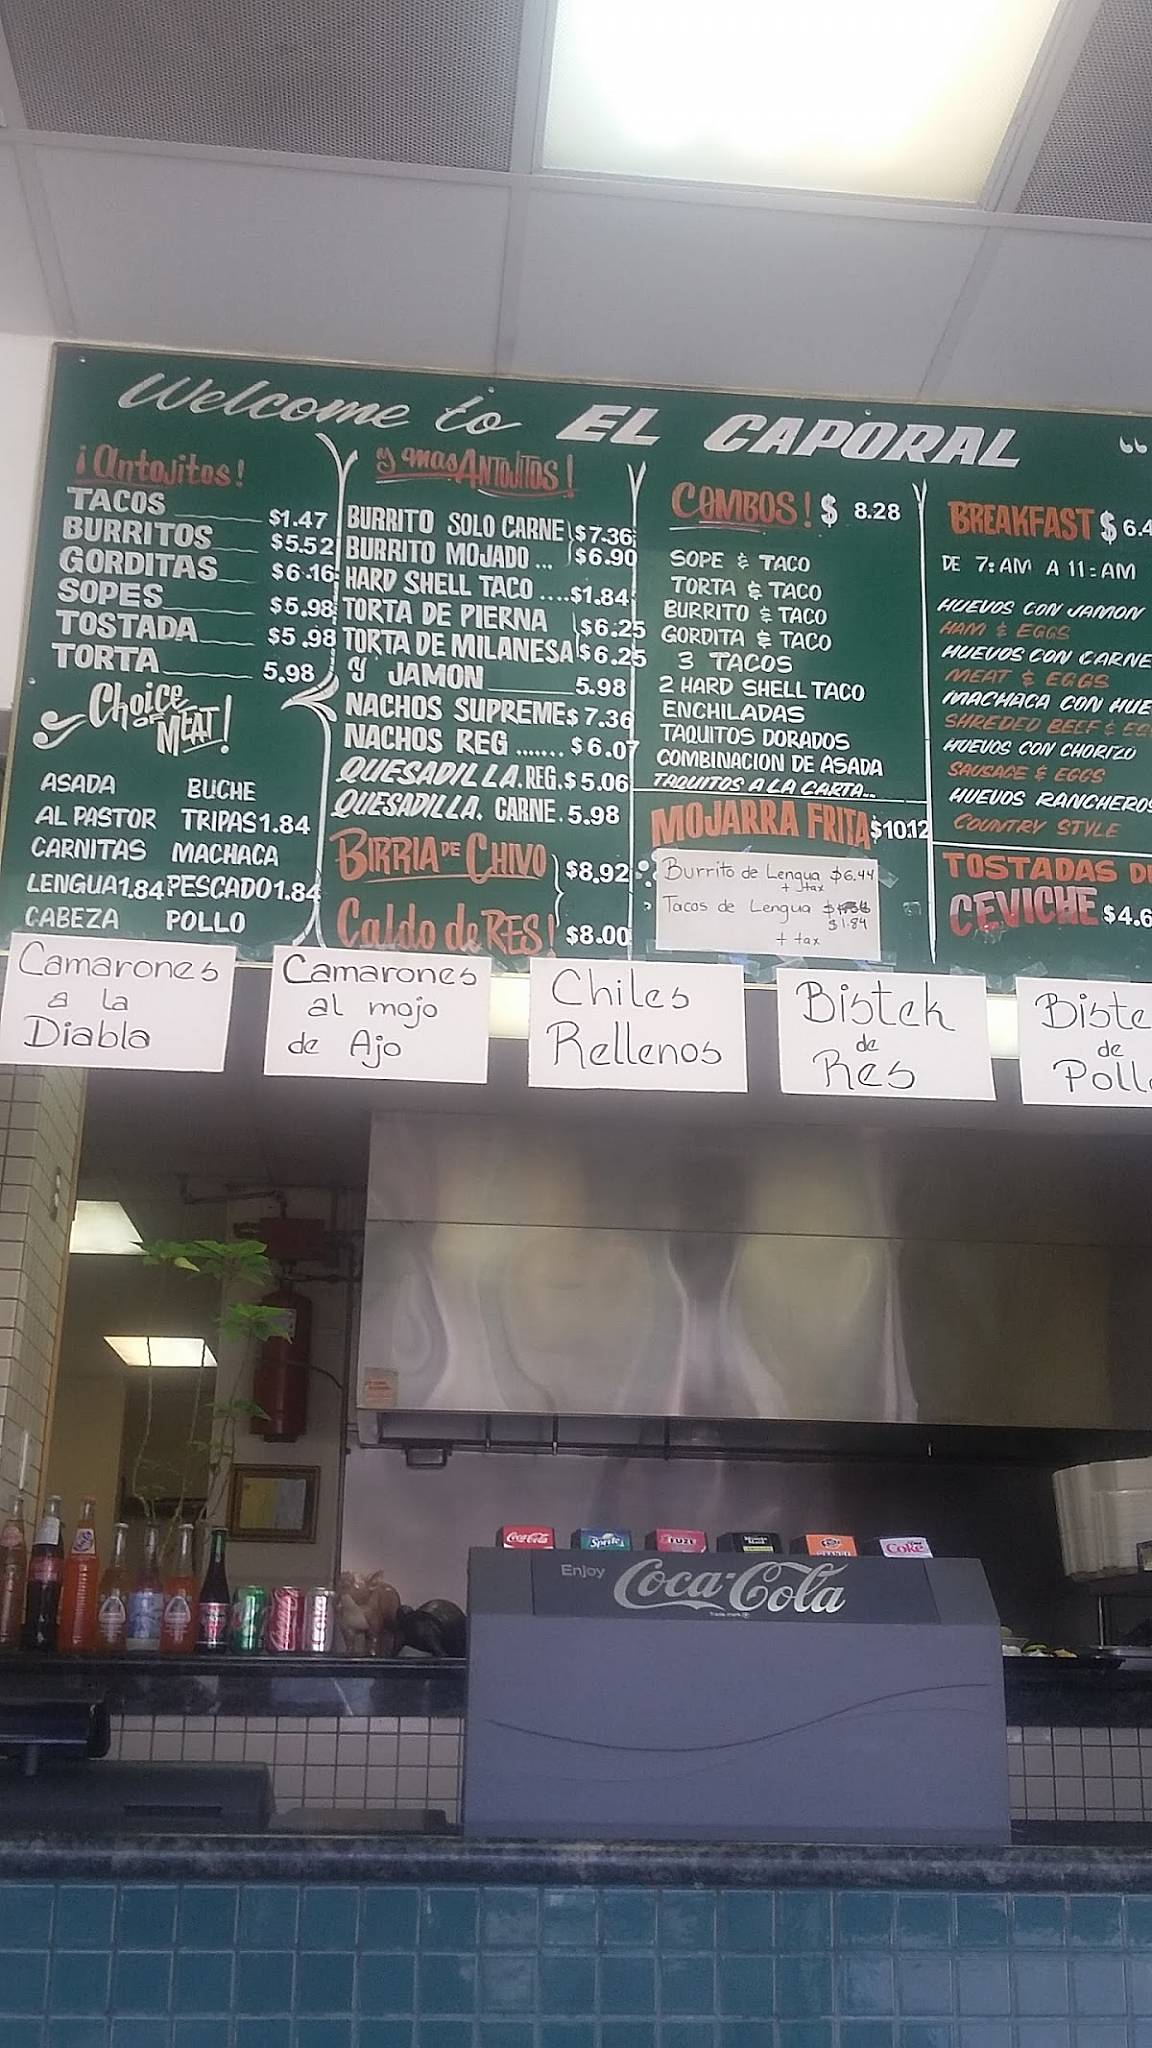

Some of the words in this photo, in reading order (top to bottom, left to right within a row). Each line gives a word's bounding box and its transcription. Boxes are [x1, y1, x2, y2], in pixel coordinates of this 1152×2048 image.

[117, 372, 410, 429] Welcome
[435, 395, 523, 435] to
[555, 404, 661, 446] EL
[703, 414, 1020, 469] CAPORAL
[67, 486, 166, 515] TACOS
[268, 508, 329, 531] $1.47
[820, 493, 838, 528] $
[854, 502, 901, 521] 8.28
[347, 504, 434, 534] BURRITO
[448, 512, 495, 539] SOLO
[501, 515, 564, 543] CARNE
[574, 524, 634, 546] $7.36
[948, 500, 1095, 541] BREAKFAST
[1100, 510, 1118, 545] $
[62, 516, 213, 551] BURRITOS
[270, 533, 335, 556] $5.52
[59, 545, 218, 581] GORDITAS
[346, 534, 436, 565] BURRITO
[446, 542, 529, 569] MOJADO
[574, 548, 638, 567] $6.90
[670, 550, 724, 569] SOPE
[759, 554, 811, 573] TACO
[942, 554, 961, 572] DE
[1046, 560, 1059, 576] A
[57, 577, 164, 609] SOPES
[346, 566, 398, 593] HARD
[403, 569, 472, 597] SHELL
[478, 574, 534, 600] TACO
[570, 585, 630, 607] $1.84
[670, 576, 736, 596] TORTA
[768, 581, 822, 601] TACO
[343, 597, 413, 624] TORTA
[422, 600, 452, 627] DE
[460, 603, 548, 632] PIERNA
[580, 618, 646, 639] $6.25
[663, 600, 749, 622] BURRITO
[777, 606, 828, 625] TACO
[936, 598, 1015, 615] HUEVOS
[1023, 602, 1064, 618] CON
[1067, 604, 1146, 621] JAMON
[56, 609, 198, 643] TOSTADA
[661, 625, 745, 646] GORDITA
[780, 631, 832, 651] TACO
[939, 621, 987, 637] HAM
[1016, 623, 1071, 641] EGGS
[342, 627, 411, 654] TORTA
[416, 630, 446, 657] DE
[451, 633, 574, 664] MILANESA
[578, 644, 647, 668] $6.25
[941, 644, 1025, 662] HUEVOS
[1028, 648, 1073, 665] CON
[1078, 650, 1152, 669] CARNE
[51, 642, 160, 674] TORTA
[263, 661, 315, 683] 5.98
[709, 651, 793, 673] TACOS
[388, 662, 484, 690] JAMON
[575, 677, 627, 697] 5.98
[659, 675, 674, 693] 2
[681, 676, 734, 696] HARD
[742, 679, 808, 699] SHELL
[811, 681, 866, 701] TACO
[944, 668, 1012, 684] MEAT
[1046, 671, 1110, 689] EGGS
[89, 681, 190, 732] Choice
[345, 692, 443, 721] NACHOS
[453, 697, 566, 727] SUPREME
[566, 707, 635, 729] $7.36
[662, 700, 805, 723] ENCHILADAS
[942, 689, 1050, 711] MACHACA
[1059, 695, 1104, 713] CON
[944, 713, 1042, 732] SHREDED
[1046, 718, 1101, 735] BEEF
[344, 723, 443, 754] NACHOS
[456, 728, 509, 755] REG
[571, 736, 640, 761] $6.07
[659, 724, 755, 746] TAQUITOS
[762, 730, 850, 751] DORADOS
[942, 738, 1012, 755] HUEVOS
[1018, 741, 1057, 757] CON
[1060, 742, 1137, 761] CHORIZO
[657, 749, 785, 773] COMBINACION
[791, 754, 815, 774] DE
[820, 756, 884, 777] ASADA
[947, 761, 1029, 781] SAUSAGE
[1054, 768, 1107, 784] EGGS
[40, 772, 116, 795] ASADA
[187, 778, 256, 801] BUCHE
[564, 771, 630, 793] $5.06
[653, 772, 745, 792] TAQUITOS
[749, 777, 763, 793] A
[766, 778, 797, 794] LA
[948, 787, 1026, 806] HUEVOS
[35, 805, 67, 827] AL
[74, 806, 157, 829] PASTOR
[181, 808, 258, 834] TRIPAS
[567, 805, 620, 826] 5.98
[650, 799, 800, 848] MOJARRA
[807, 802, 872, 850] FRITA
[1057, 818, 1121, 838] STYLE
[31, 836, 147, 861] CARNITAS
[172, 842, 279, 867] MACHACA
[565, 860, 630, 884] $8.92
[662, 856, 734, 881] Burrito
[741, 865, 758, 879] de
[766, 863, 820, 892] Lengua
[830, 868, 875, 885] $6.44
[942, 852, 1118, 883] TOSTADAS
[24, 906, 119, 930] CABEZA
[166, 908, 246, 934] POLLO
[662, 895, 708, 913] Tacos
[718, 899, 735, 913] de
[750, 899, 811, 924] Lengua
[949, 886, 1099, 937] CEVICHE
[445, 902, 481, 953] de
[566, 925, 631, 947] $8.00
[794, 931, 821, 945] tax
[19, 940, 219, 982] Camarones
[282, 953, 477, 986] Camarones
[48, 991, 68, 1008] a
[552, 968, 690, 1009] Chiles
[308, 993, 344, 1017] al
[369, 996, 438, 1029] mojo
[795, 979, 956, 1031] Bistek
[24, 1015, 150, 1050] Diabla
[546, 1020, 722, 1069] Rellenos
[855, 1033, 880, 1053] de
[288, 1032, 320, 1055] de
[350, 1029, 402, 1069] Ajo
[1097, 1039, 1124, 1057] de
[812, 1049, 916, 1090] Res
[1052, 1059, 1152, 1093] Poll
[589, 1536, 618, 1548] Sprite
[885, 1542, 924, 1554] Coke
[561, 1564, 606, 1580] Enjoy
[613, 1558, 849, 1614] Coca-Cola
